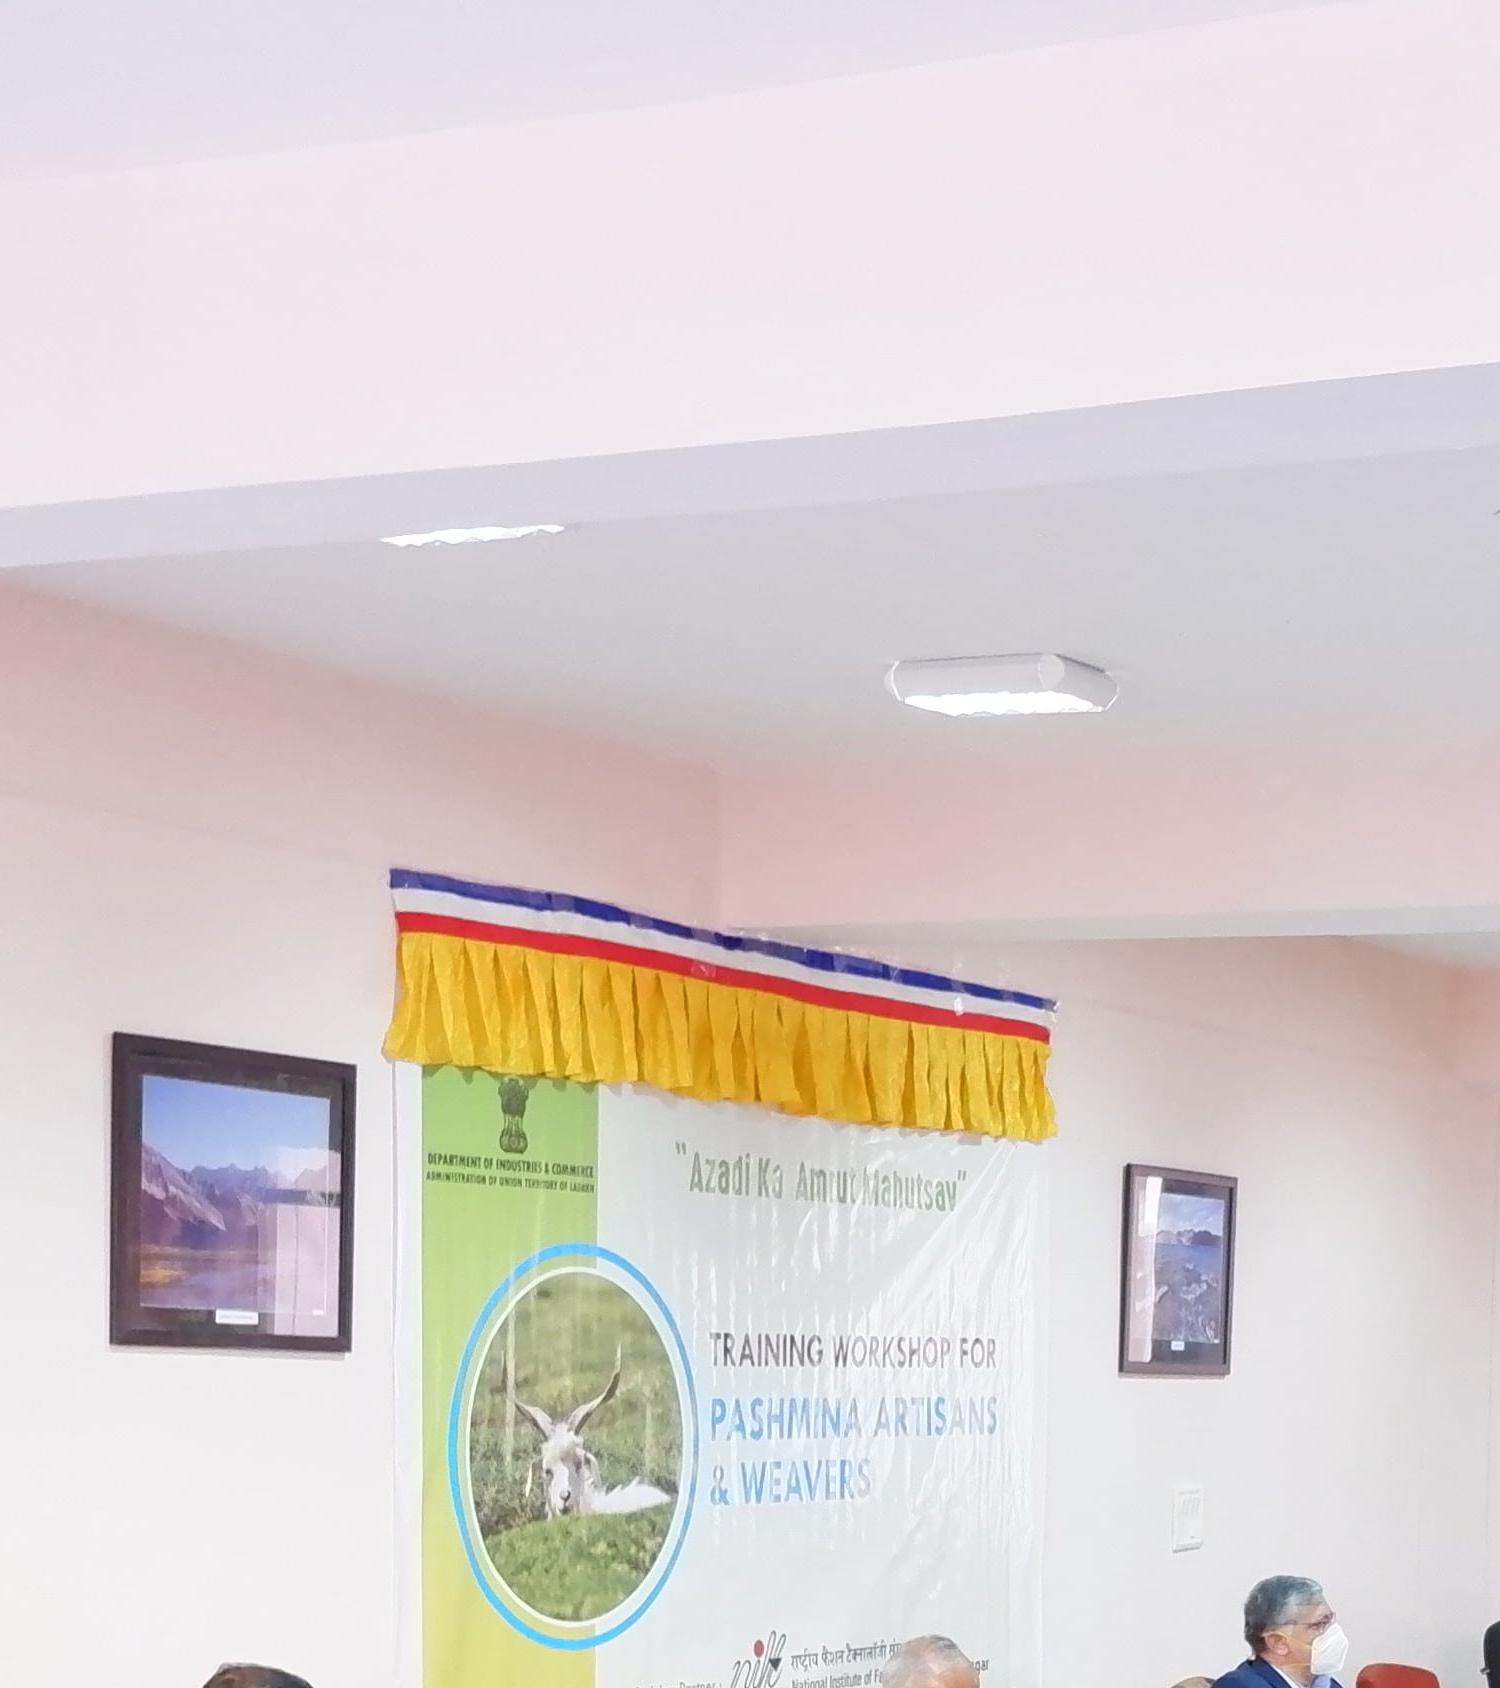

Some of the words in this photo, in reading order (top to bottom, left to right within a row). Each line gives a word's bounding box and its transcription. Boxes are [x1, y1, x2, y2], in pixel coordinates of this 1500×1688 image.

[483, 1157, 494, 1169] OF
[757, 1157, 784, 1199] Ka
[795, 1161, 856, 1204] Amrut
[709, 1332, 824, 1368] TRAINING
[832, 1335, 951, 1369] WORKSHOP
[960, 1337, 997, 1369] FOR
[711, 1397, 862, 1442] PASHMINA
[873, 1396, 998, 1438] ARTISANS
[709, 1464, 730, 1506] &
[740, 1457, 871, 1505] WEAVERS
[829, 1672, 863, 1688] Institute
[864, 1669, 873, 1685] of
